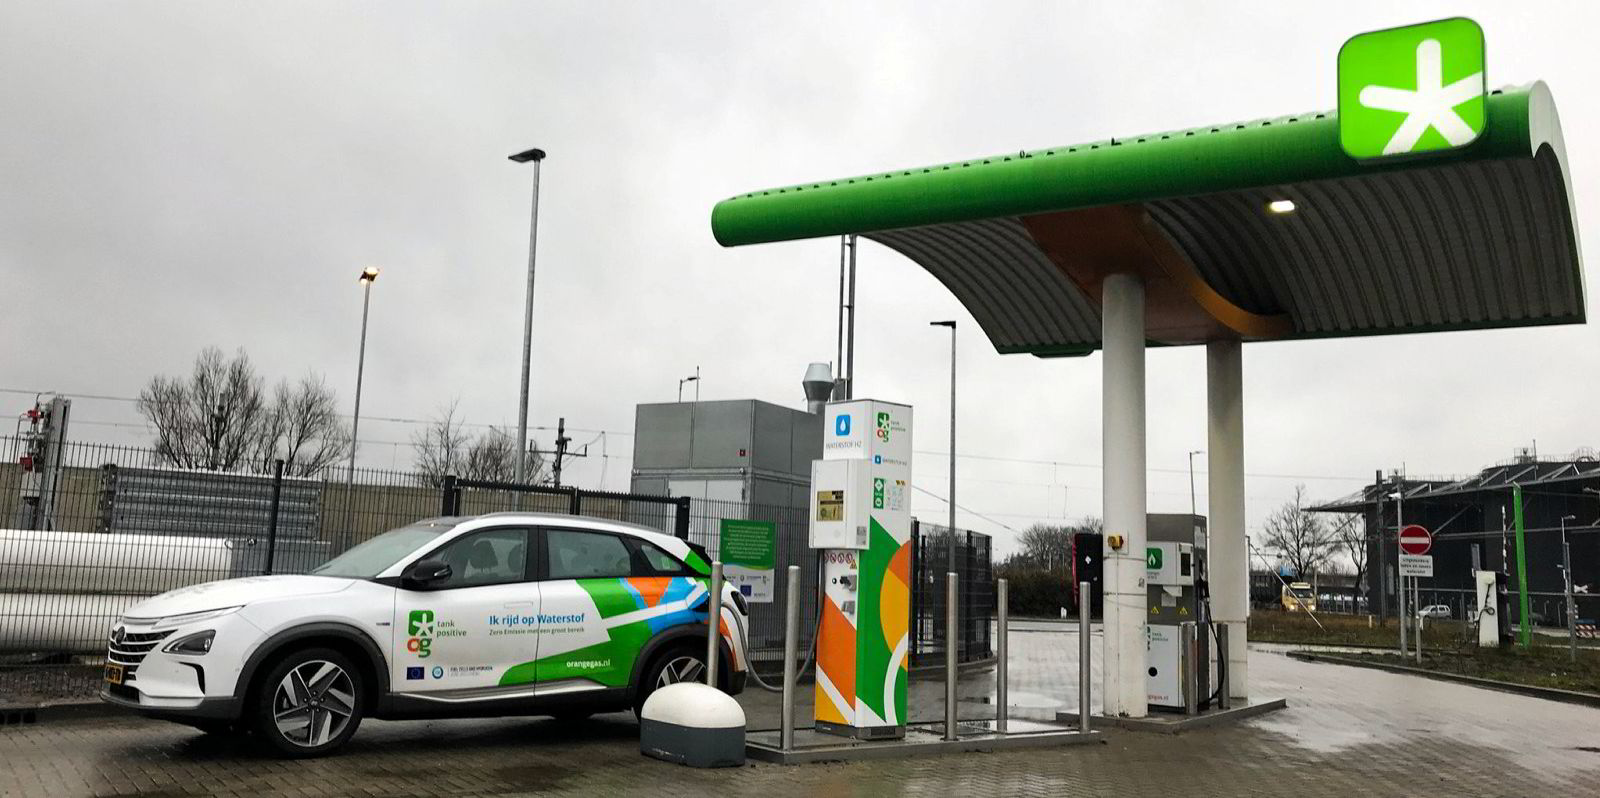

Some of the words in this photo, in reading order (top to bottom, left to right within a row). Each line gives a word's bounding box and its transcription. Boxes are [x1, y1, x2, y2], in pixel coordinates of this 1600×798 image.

[826, 441, 852, 449] WATERSTOF
[437, 620, 455, 628] tank
[489, 615, 499, 625] Ik
[502, 614, 519, 627] rijd
[521, 616, 534, 626] op
[537, 613, 584, 624] Waterstof
[437, 629, 467, 638] positive
[567, 658, 610, 669] orangegas.nl
